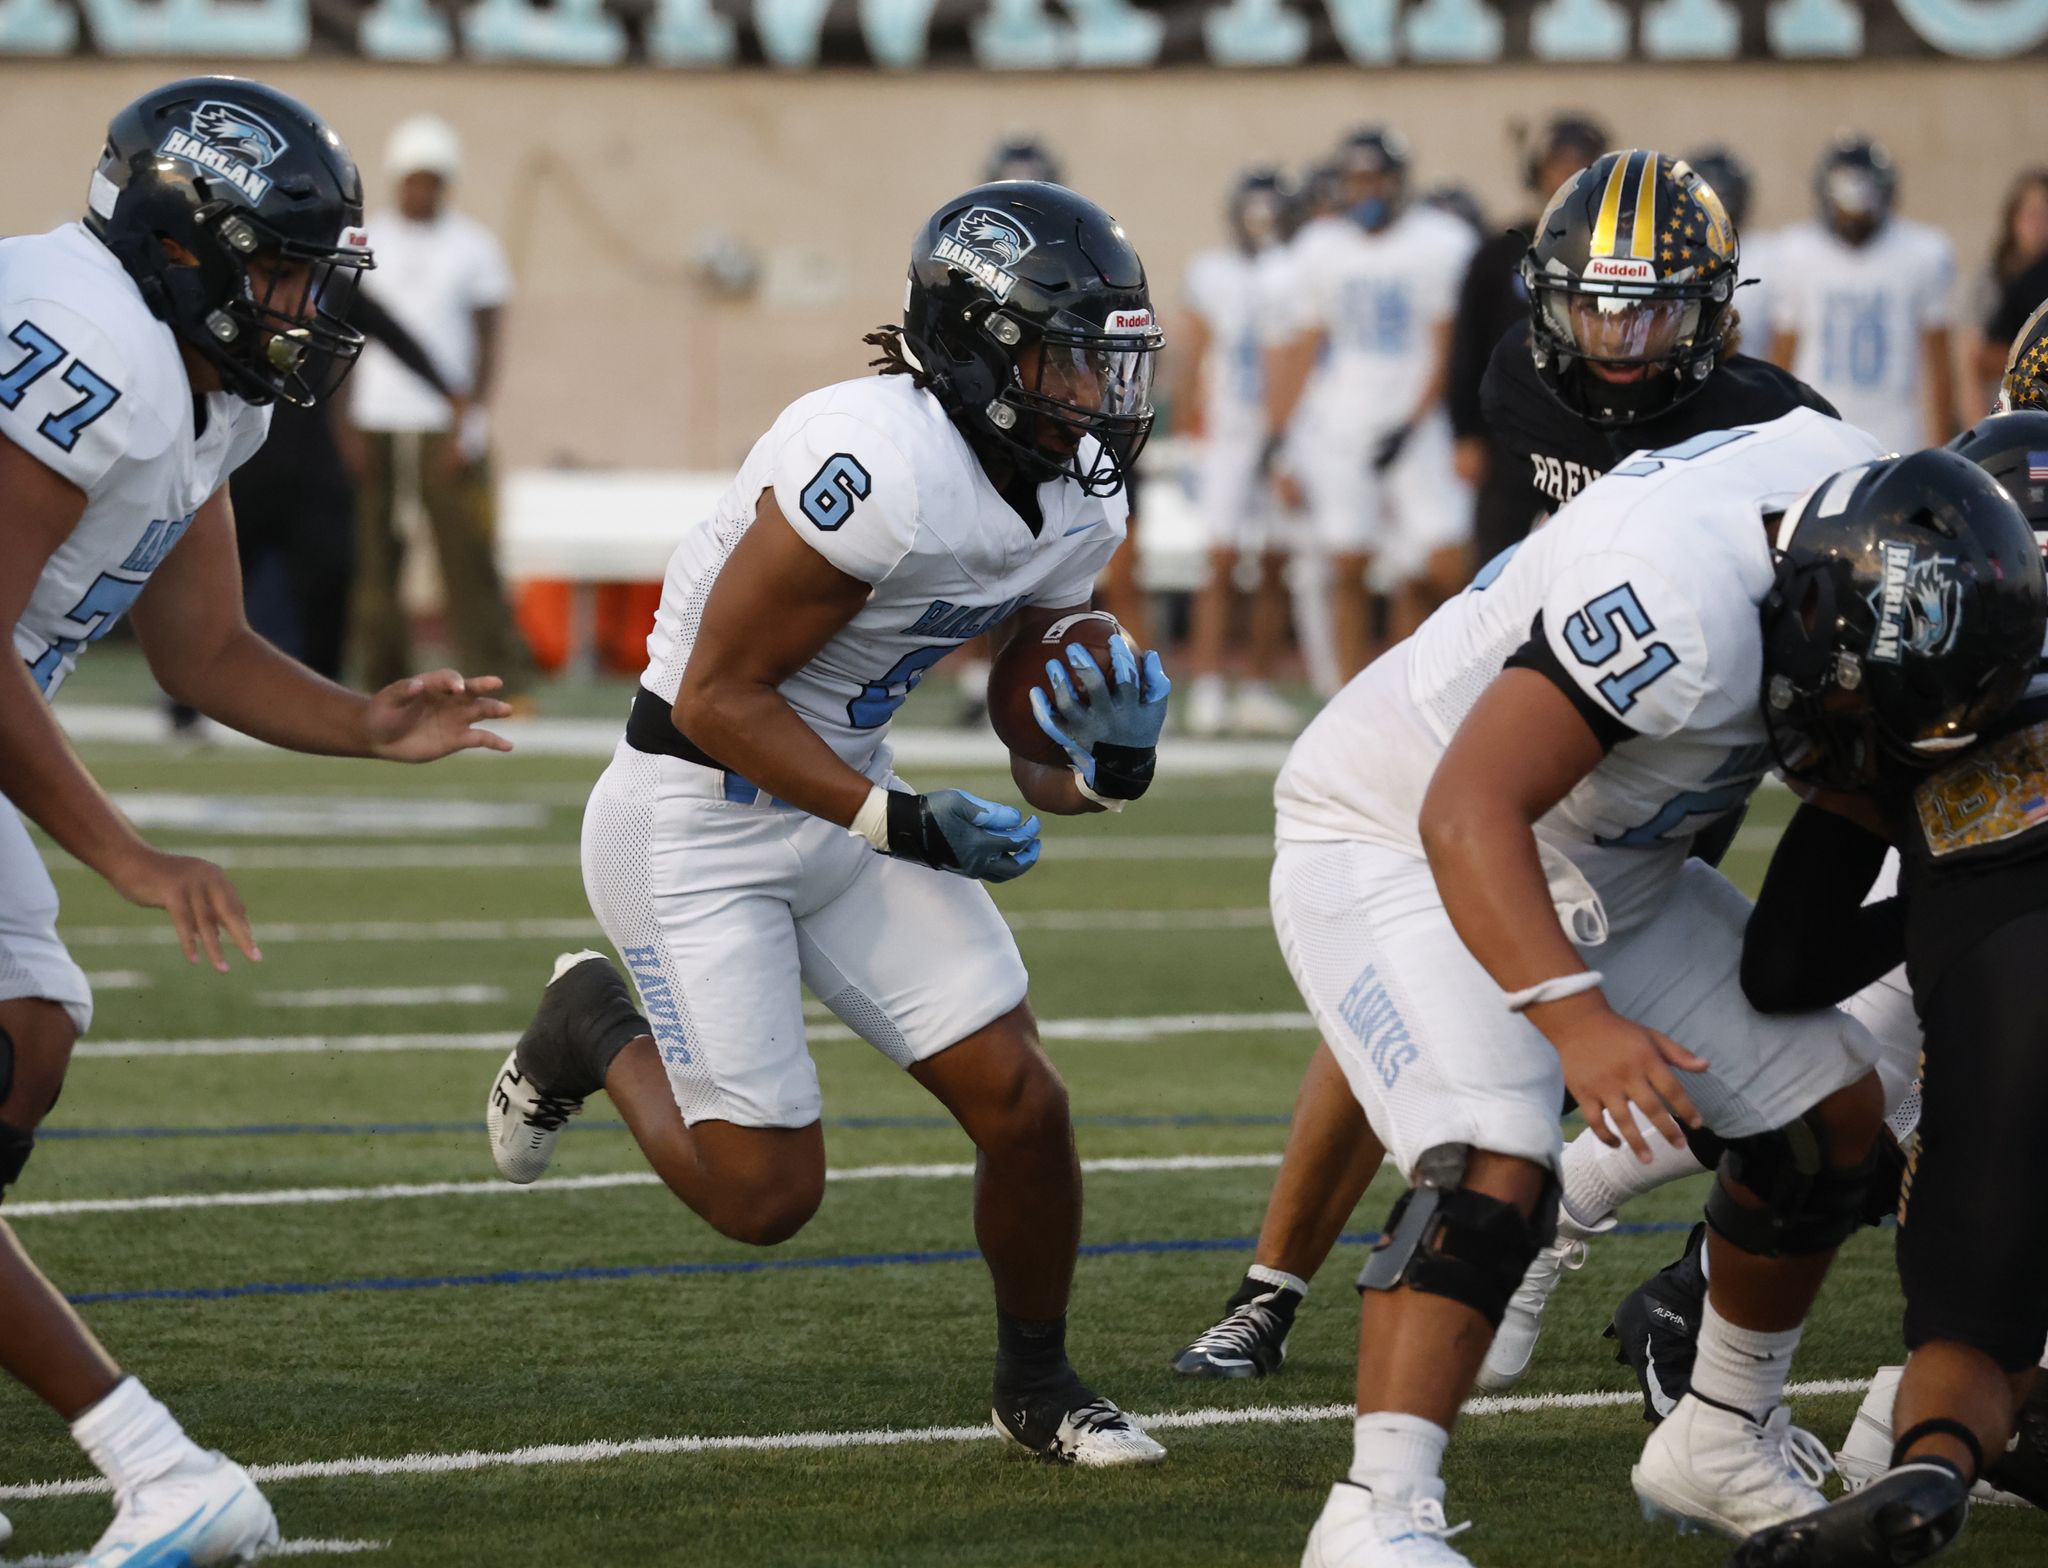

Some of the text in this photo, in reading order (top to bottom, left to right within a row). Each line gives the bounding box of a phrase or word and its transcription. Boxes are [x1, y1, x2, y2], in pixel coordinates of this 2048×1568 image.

[164, 131, 268, 201] HARLAN
[934, 237, 1015, 297] HARLAN
[1592, 262, 1648, 278] Riddell
[1115, 314, 1150, 328] Riddell
[0, 319, 122, 454] 77
[799, 452, 872, 531] 6
[1873, 545, 1911, 659] HARLAN
[1562, 581, 1681, 717] 51
[622, 944, 693, 1065] HAWKS
[1338, 963, 1420, 1089] HAWKS
[1652, 1307, 1685, 1327] ALPHA
